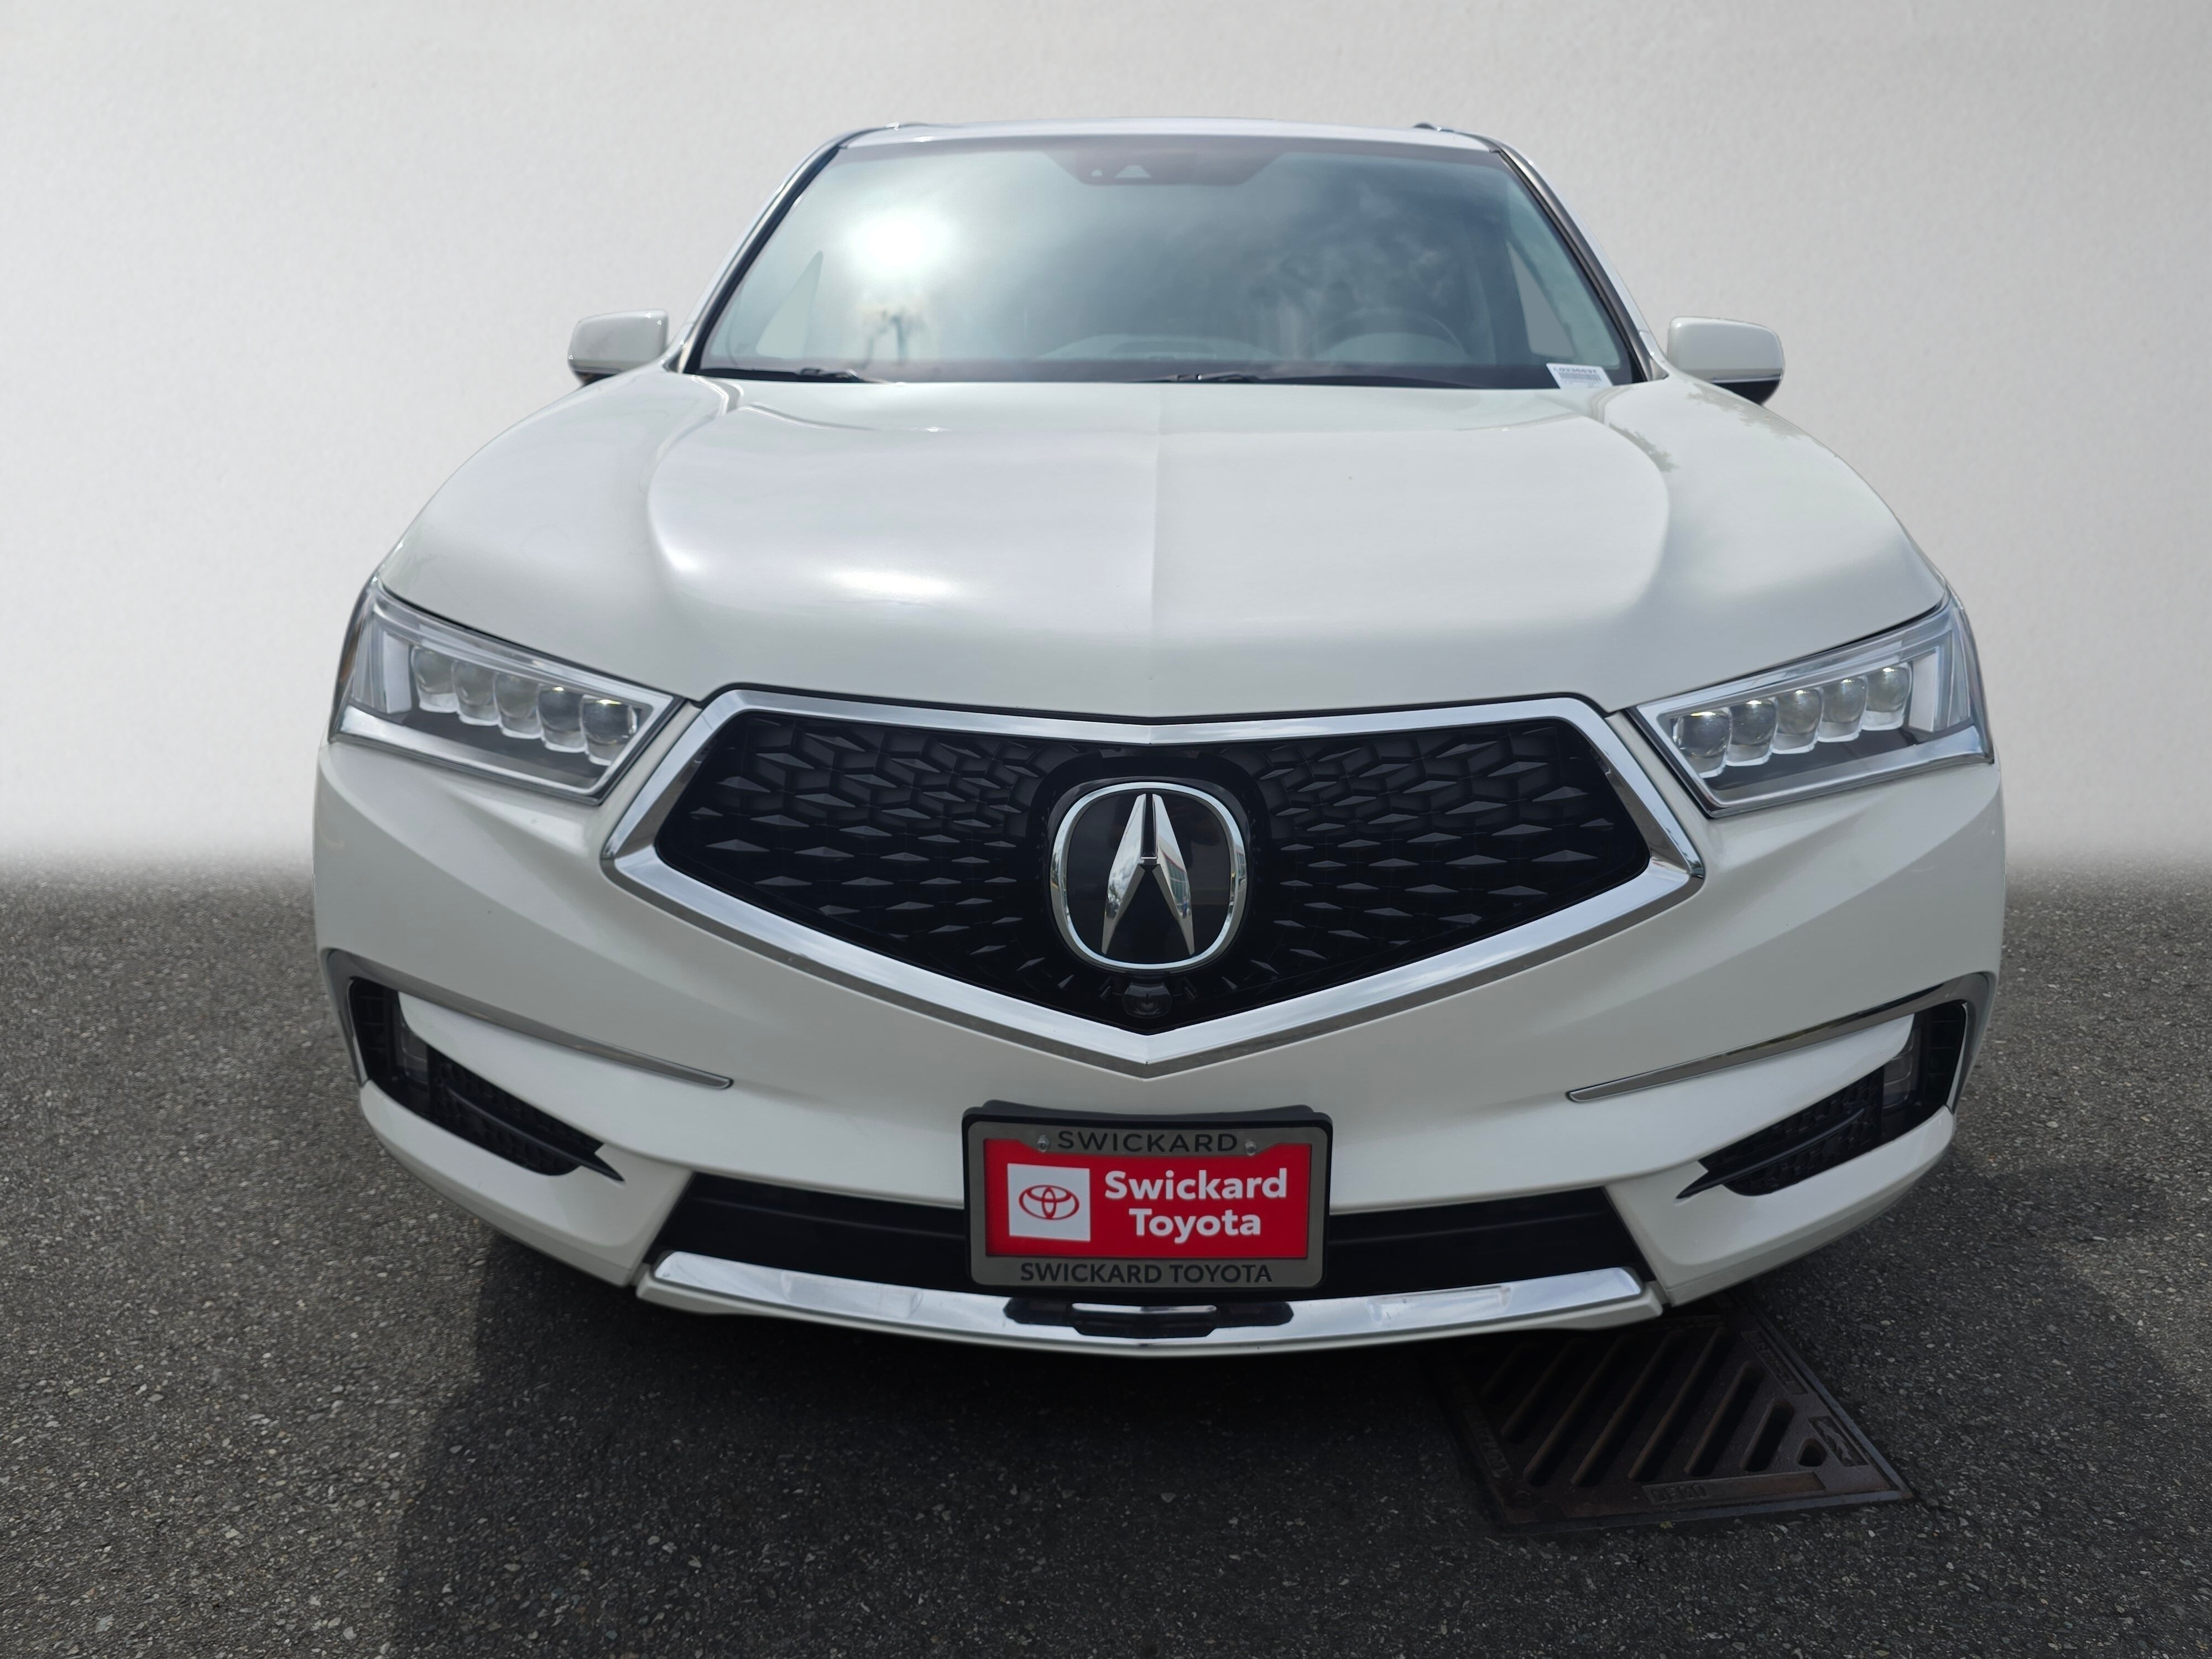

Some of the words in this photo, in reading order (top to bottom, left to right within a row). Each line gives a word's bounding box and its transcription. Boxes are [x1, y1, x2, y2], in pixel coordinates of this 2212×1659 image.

[1058, 1130, 1238, 1152] SWICKARD
[1105, 1168, 1287, 1200] Swickard
[1129, 1208, 1261, 1244] Toyota
[1020, 1262, 1162, 1284] SWICKARD
[1170, 1264, 1272, 1284] TOYOTA
